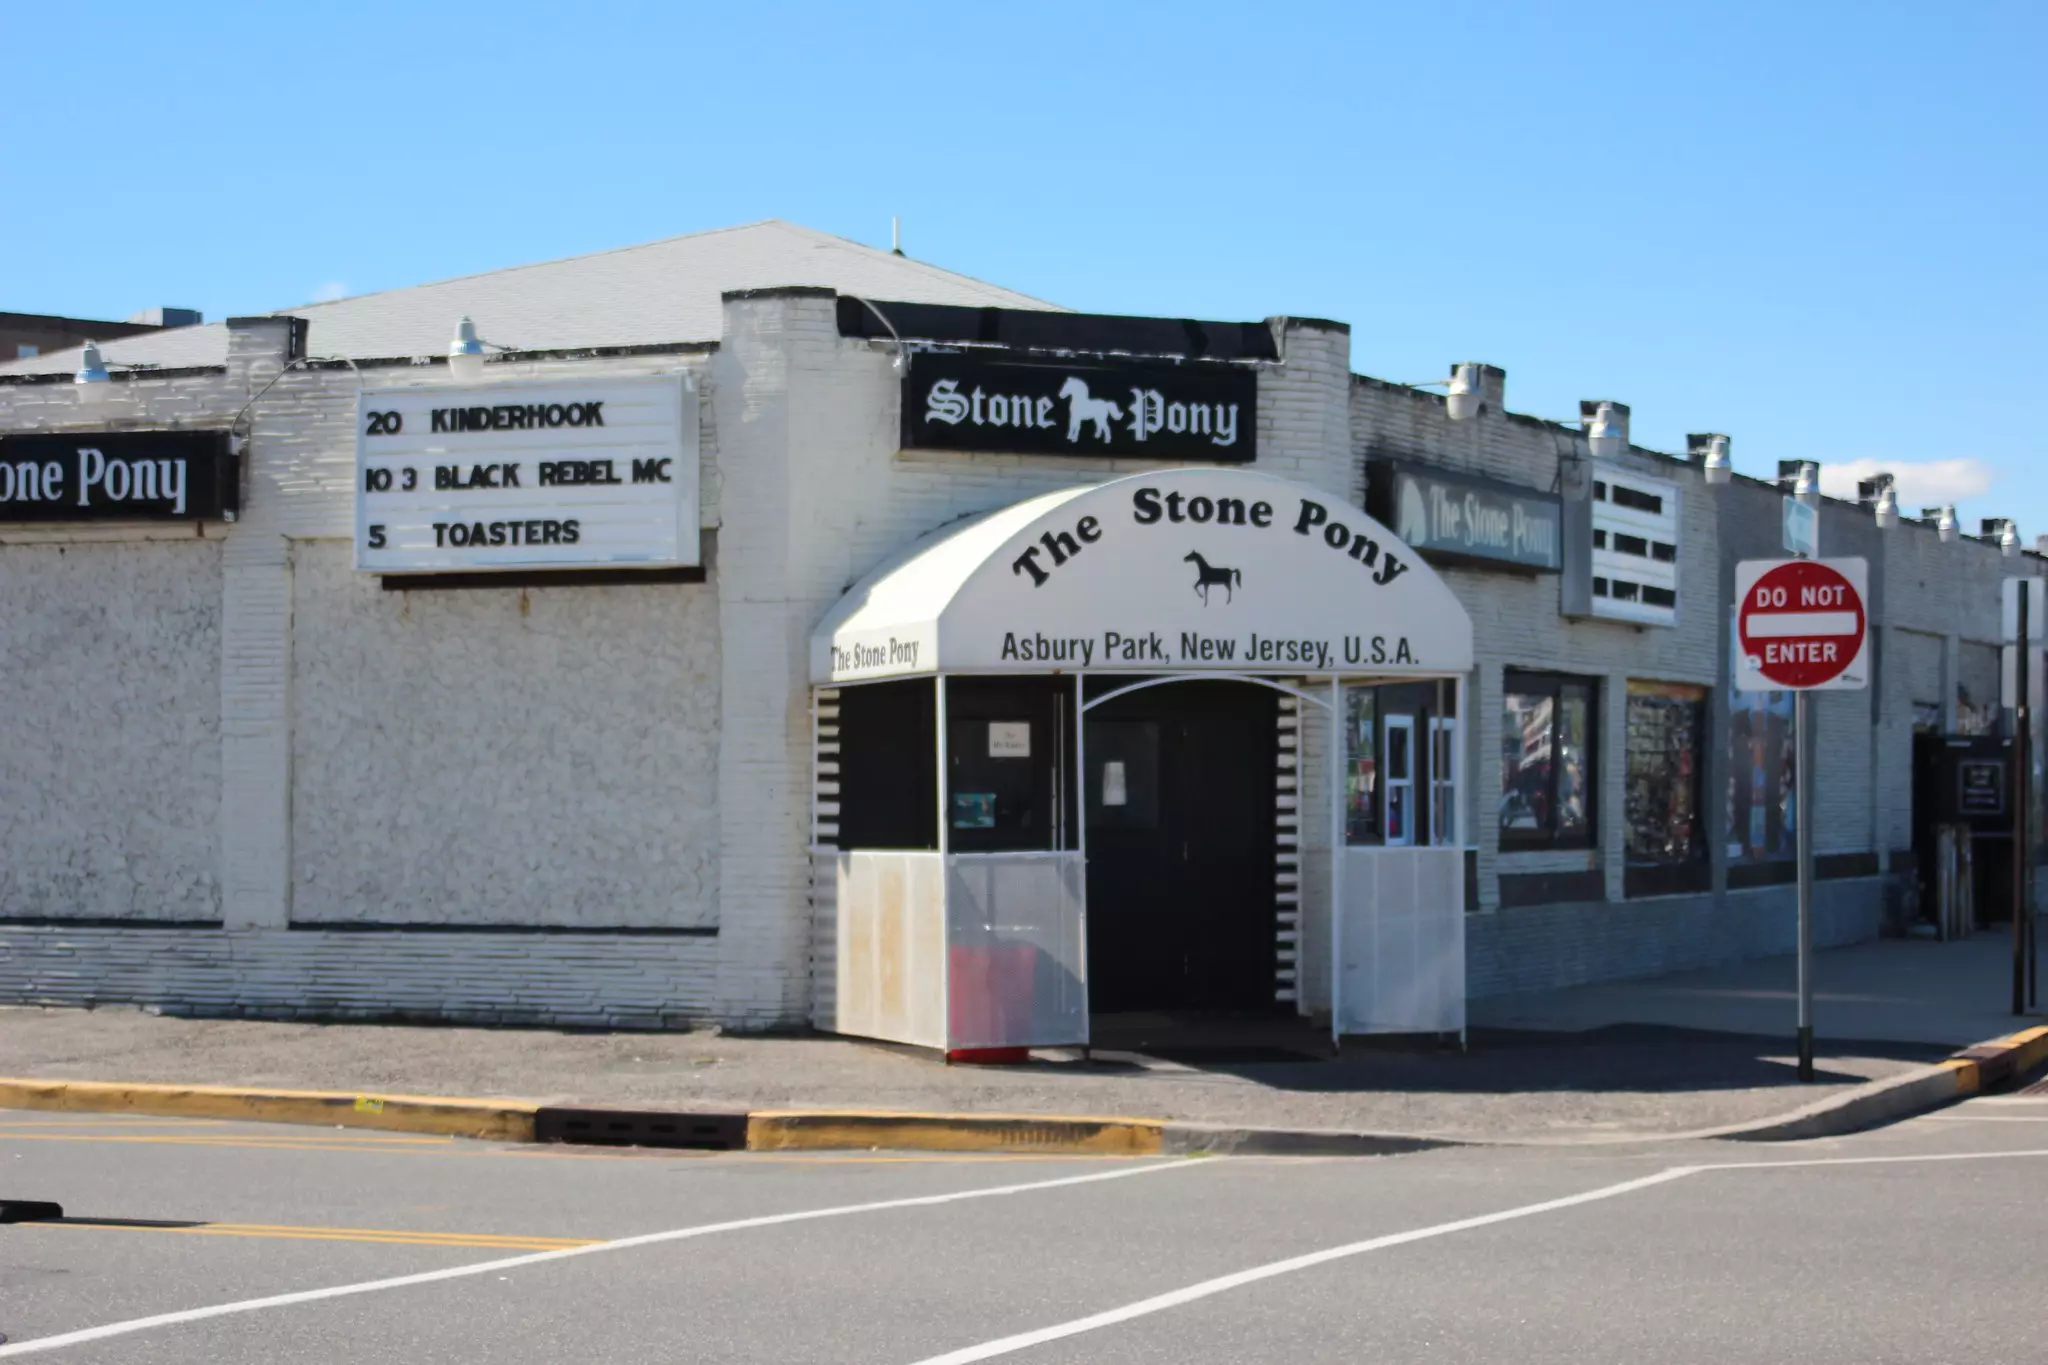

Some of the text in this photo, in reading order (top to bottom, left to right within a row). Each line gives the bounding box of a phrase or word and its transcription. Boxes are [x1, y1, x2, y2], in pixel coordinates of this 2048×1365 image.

[366, 401, 605, 435] 20 KINDERHOOK
[924, 378, 1238, 446] Stone Pony
[77, 448, 187, 514] Pony
[366, 458, 671, 492] 10 3 BLACK REBEL MC
[368, 519, 579, 549] 5 TOASTERS
[1012, 487, 1410, 588] The Stone Pony
[1430, 485, 1460, 542] The
[1464, 493, 1509, 548] Stone
[1512, 503, 1554, 568] Pony
[1757, 585, 1845, 608] DO NOT
[831, 637, 919, 672] The Stone Pony
[1002, 632, 1420, 669] Asbury Park, New Jersey, U.S.A.
[1765, 643, 1837, 664] ENTER
